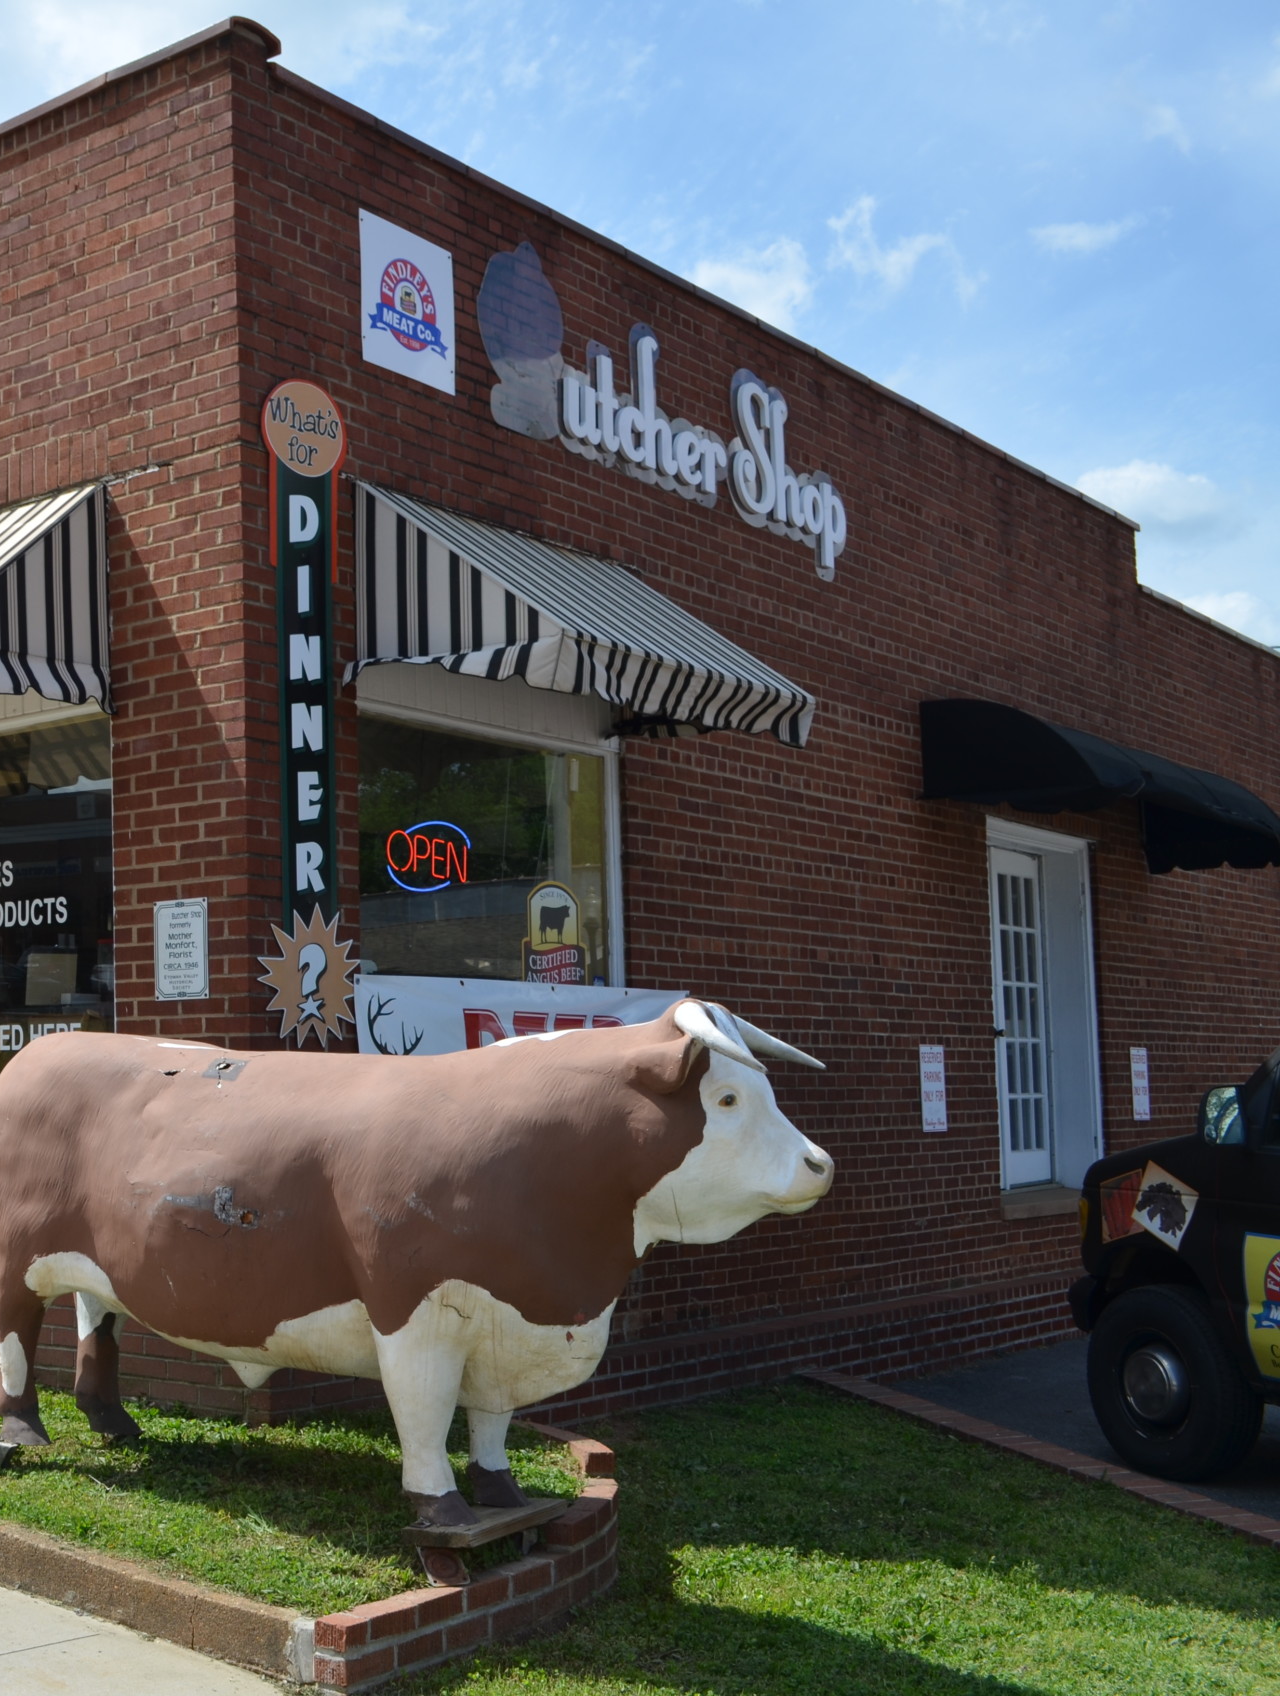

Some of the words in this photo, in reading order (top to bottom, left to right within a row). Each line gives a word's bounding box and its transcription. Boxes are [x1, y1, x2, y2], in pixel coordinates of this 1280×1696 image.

[382, 261, 435, 314] FINDLEY'S
[383, 307, 415, 335] MEAT
[270, 396, 339, 440] What's
[288, 435, 318, 467] for
[733, 381, 846, 569] Shop
[289, 494, 326, 893] DINNER
[386, 830, 467, 883] OPEN
[165, 941, 197, 950] Monfort,
[168, 932, 192, 940] Mother
[169, 951, 192, 959] Florist
[529, 949, 578, 970] CERTIFIED
[526, 968, 559, 984] ANGUS
